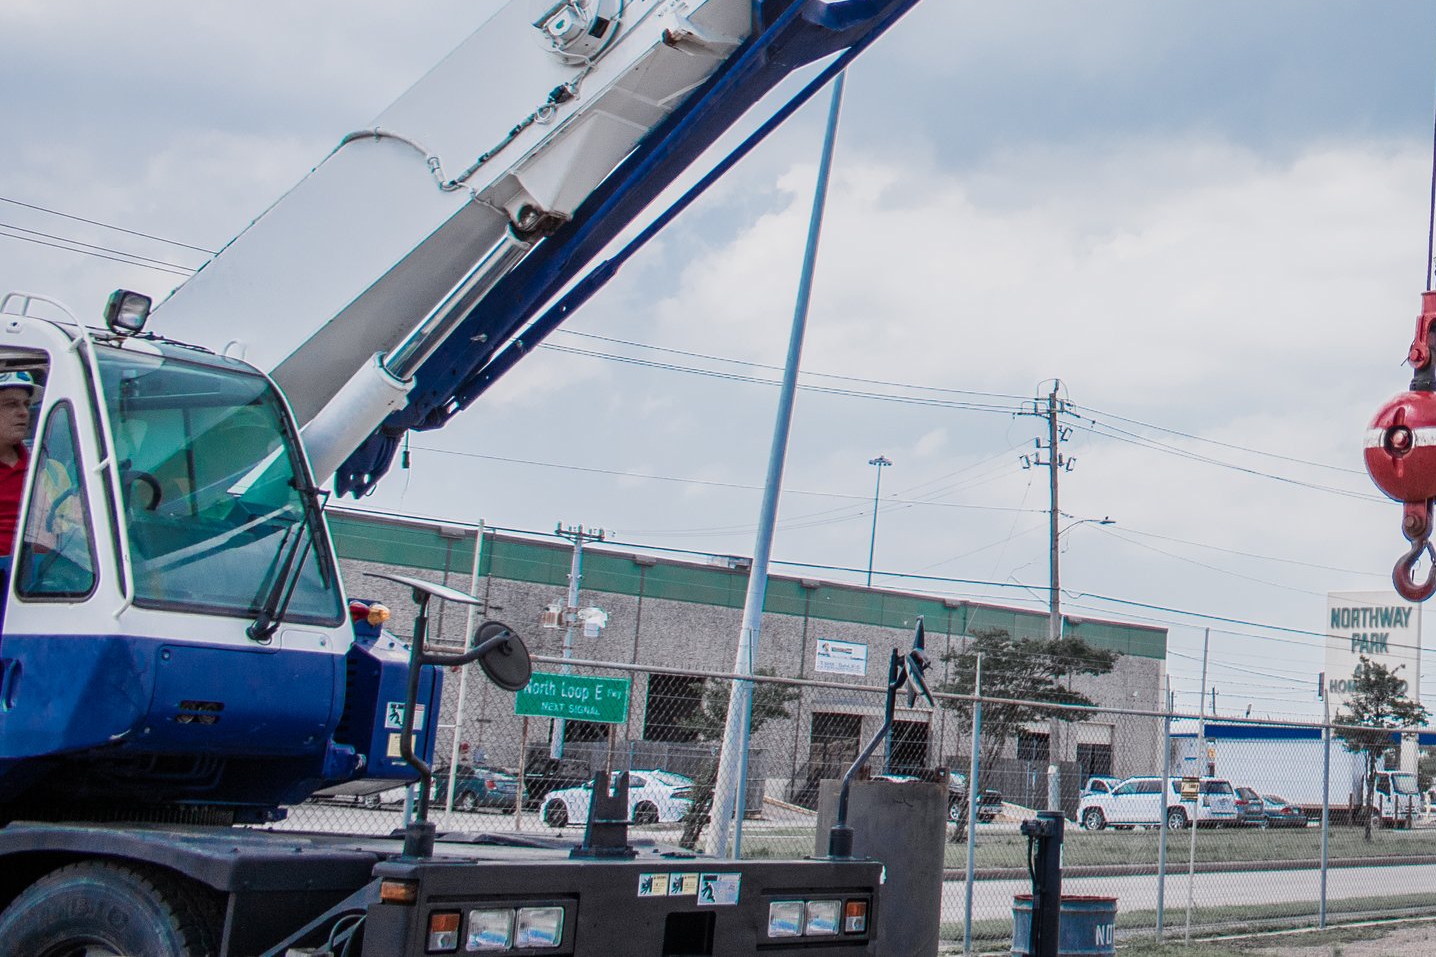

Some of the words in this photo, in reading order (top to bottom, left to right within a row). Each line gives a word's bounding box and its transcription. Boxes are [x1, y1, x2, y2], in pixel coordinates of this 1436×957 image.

[1330, 607, 1412, 629] NORTHWAY
[1351, 632, 1390, 653] PARK
[524, 678, 556, 695] North
[561, 681, 590, 702] Loop
[595, 684, 603, 700] E
[541, 702, 565, 711] NEXT
[569, 704, 601, 715] SIGNAL
